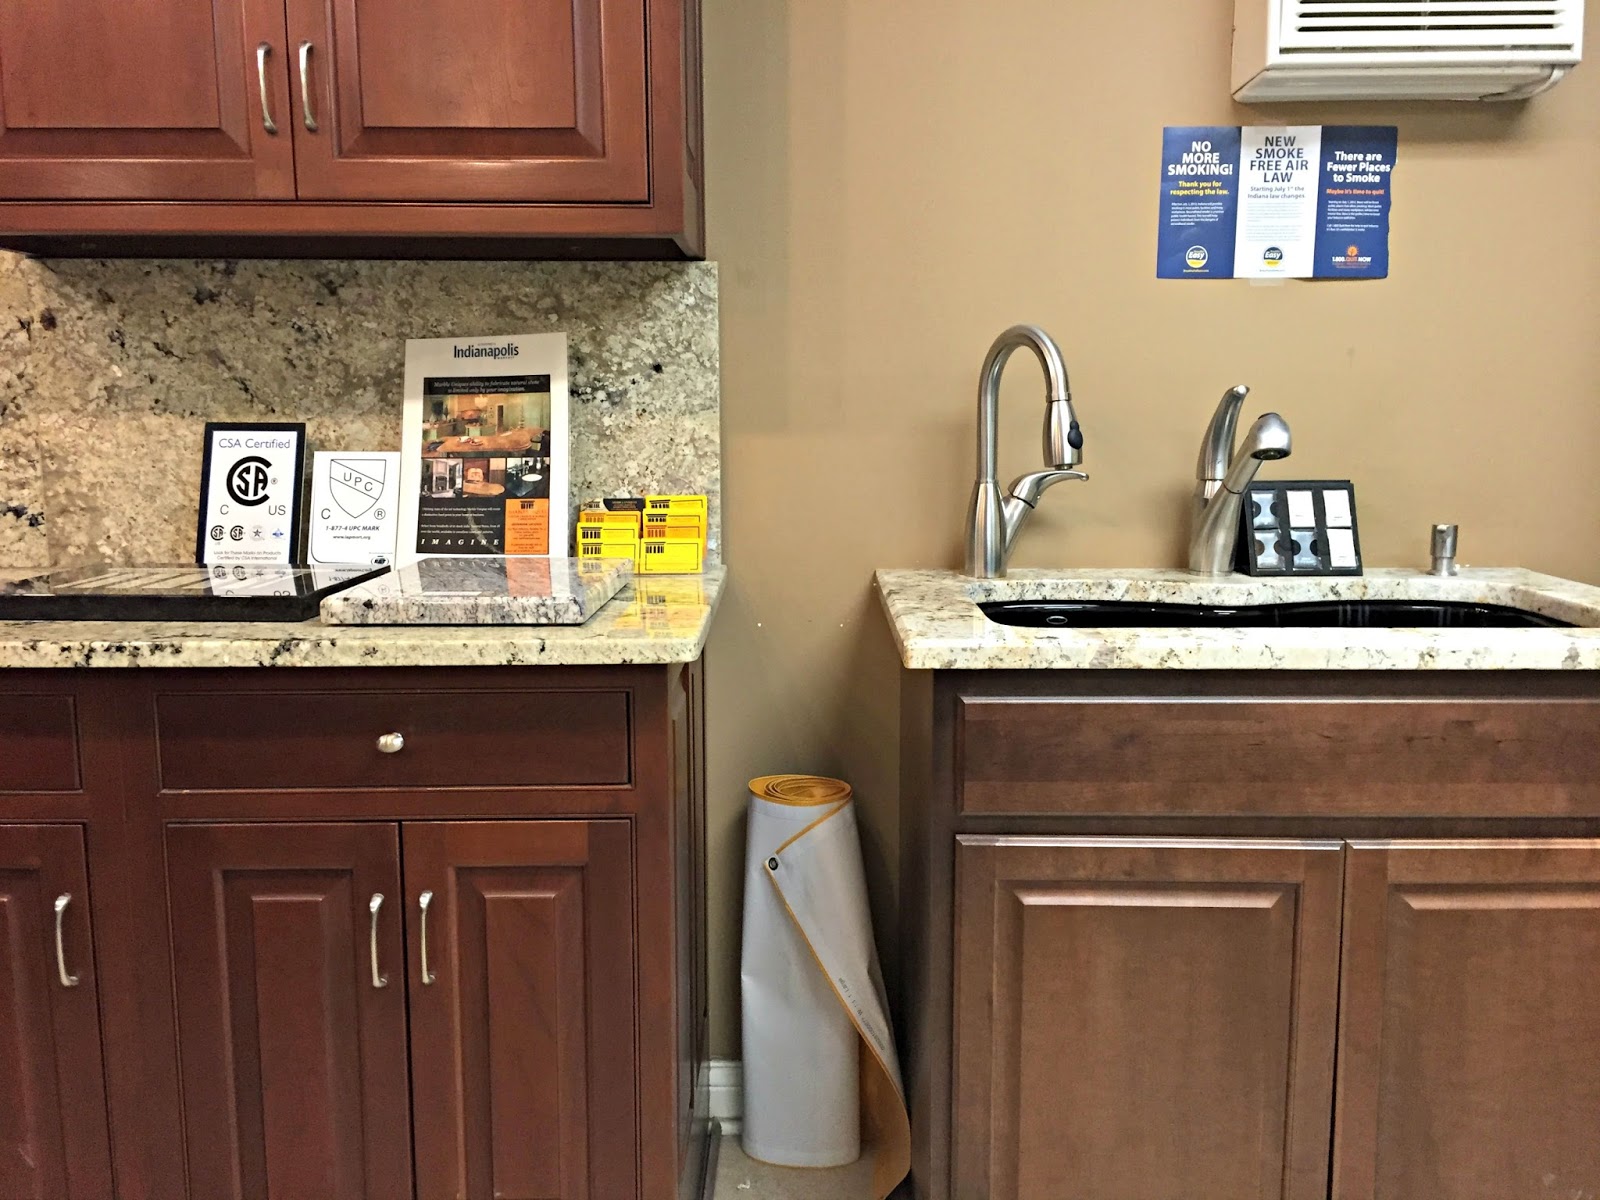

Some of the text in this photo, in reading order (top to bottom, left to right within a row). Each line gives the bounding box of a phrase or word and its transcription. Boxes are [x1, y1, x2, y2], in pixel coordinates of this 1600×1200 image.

[1191, 141, 1212, 152] NO
[1264, 136, 1296, 147] NEW
[1182, 152, 1220, 164] MORE
[1255, 148, 1304, 159] SMOKE
[1334, 151, 1382, 161] There are
[1167, 164, 1233, 176] SMOKING!
[1250, 160, 1309, 171] FREE AIR
[1326, 162, 1391, 172] Fewer Places
[1263, 172, 1293, 183] LAW
[1333, 173, 1381, 183] to Smoke
[1170, 189, 1204, 197] respecting
[1188, 251, 1206, 260] Easy
[1264, 251, 1282, 260] Easy
[453, 343, 519, 360] Indianapolis
[218, 438, 291, 449] CSA Certified
[343, 472, 373, 492] UPC
[219, 504, 287, 516] C US
[320, 508, 331, 520] C
